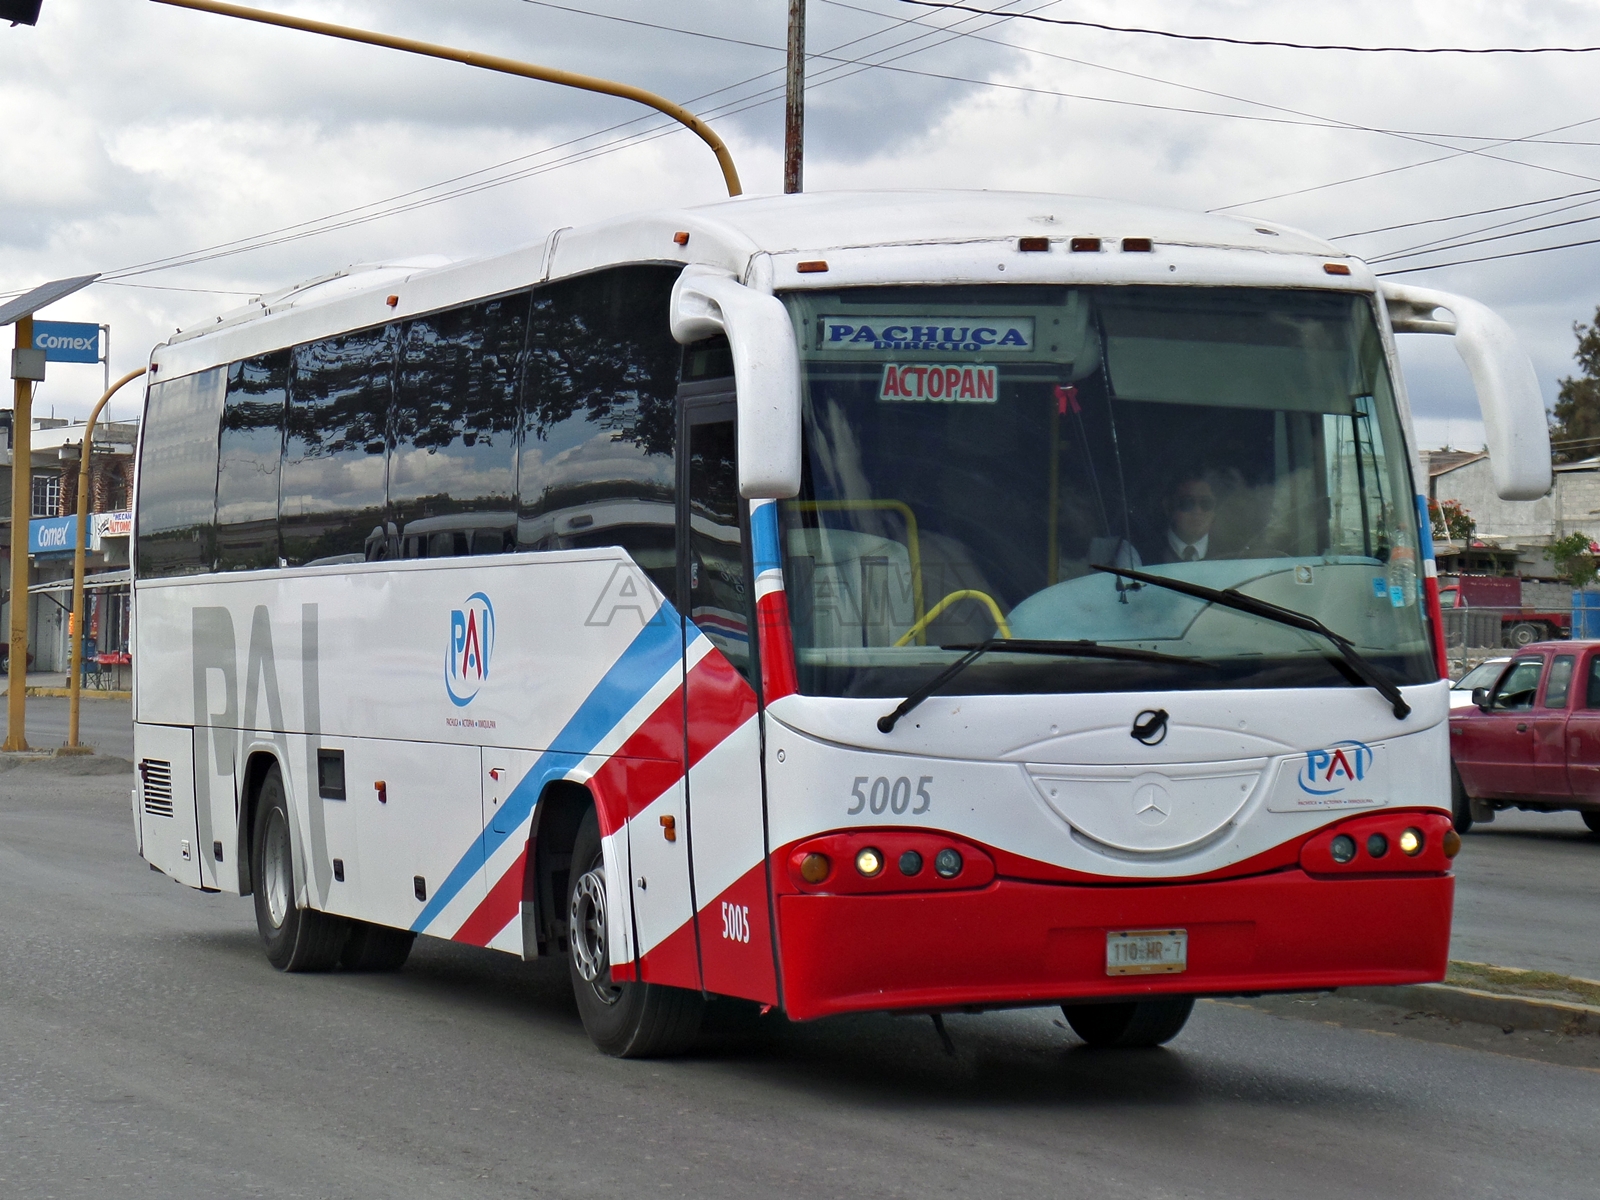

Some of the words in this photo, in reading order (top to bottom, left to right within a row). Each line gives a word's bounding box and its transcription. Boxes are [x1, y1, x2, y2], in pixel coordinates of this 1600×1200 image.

[36, 333, 97, 350] Comex
[829, 325, 1028, 346] PACHUCA
[874, 340, 982, 351] DIRECTO
[883, 366, 994, 399] ACTOPAN
[38, 521, 69, 547] Comex
[450, 608, 490, 681] PAI
[192, 602, 333, 911] PAI
[1305, 748, 1365, 783] PAI
[847, 776, 933, 815] 5005
[721, 901, 750, 944] 5005
